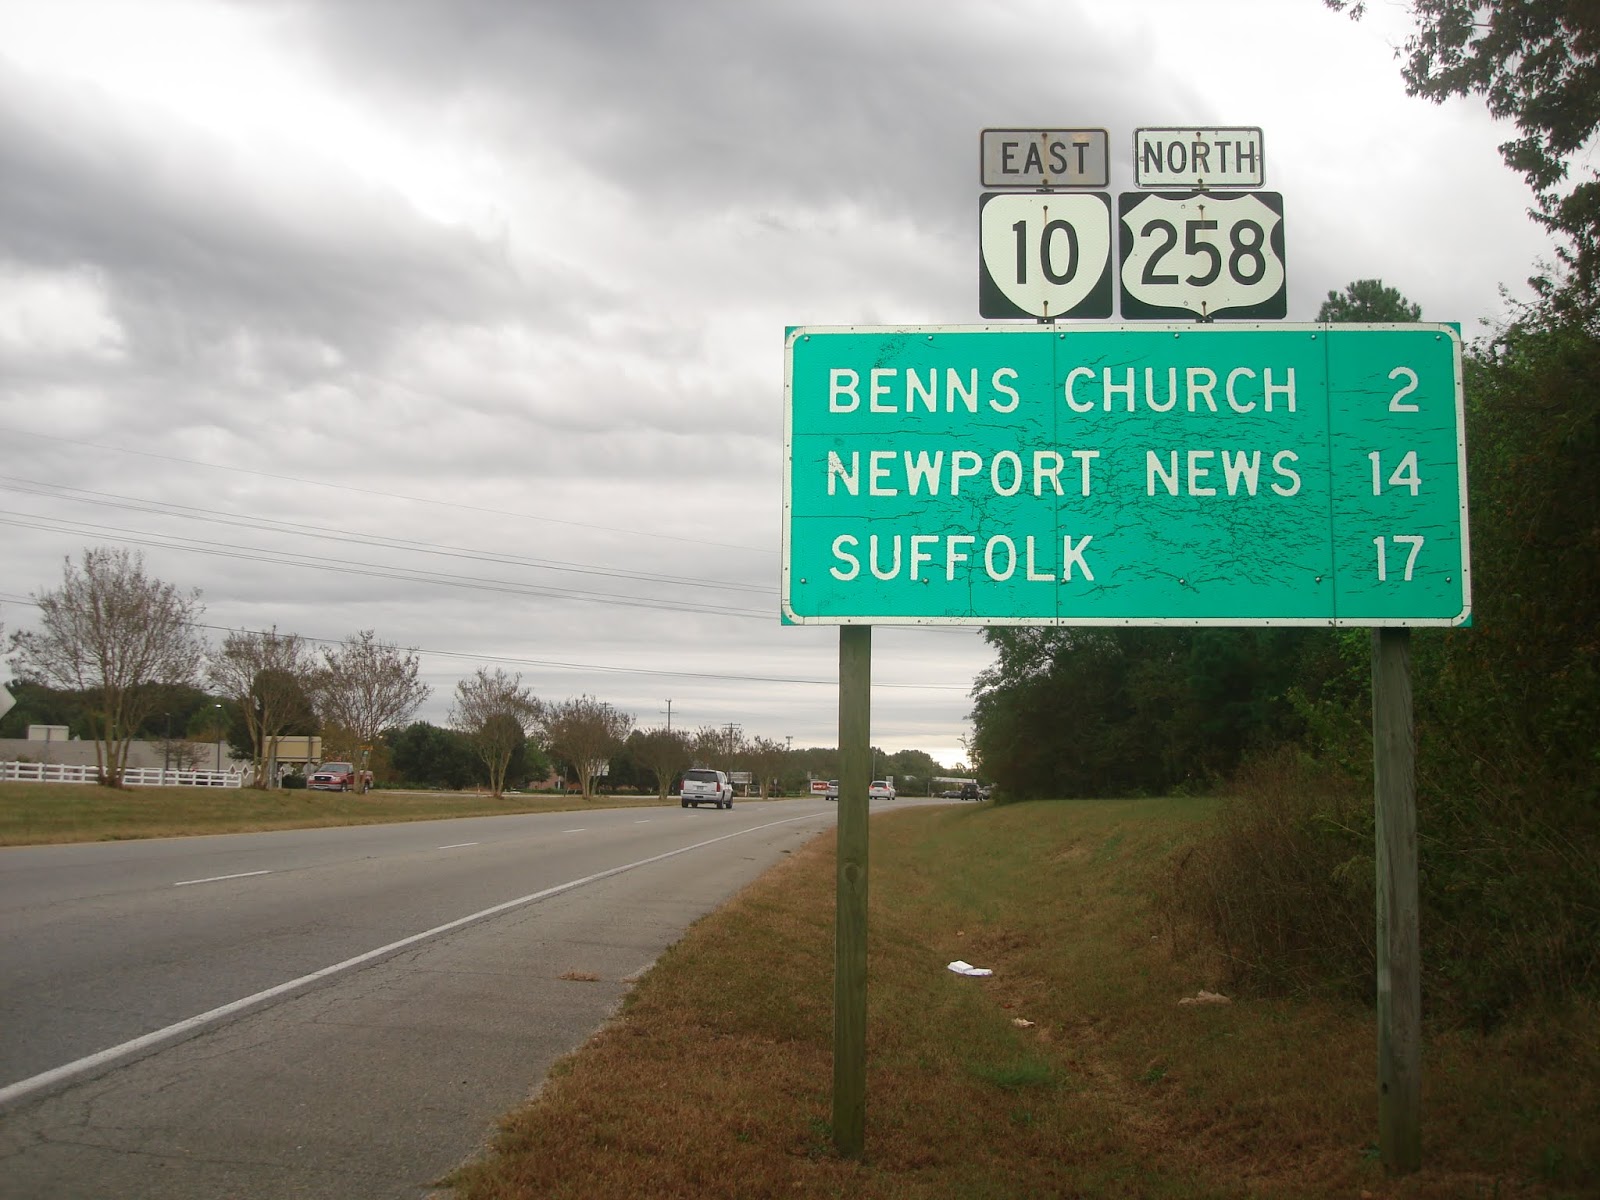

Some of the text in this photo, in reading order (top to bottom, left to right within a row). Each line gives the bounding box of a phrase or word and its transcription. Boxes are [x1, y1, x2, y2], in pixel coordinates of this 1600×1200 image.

[1002, 142, 1090, 174] EAST
[1143, 141, 1255, 173] NORTH
[1012, 219, 1078, 285] 10
[1140, 219, 1266, 286] 258
[828, 366, 1420, 414] BENNS CHURCH 2
[827, 449, 1422, 497] NEWPORT NEWS 14
[829, 534, 1425, 583] SUFFOLK 17
